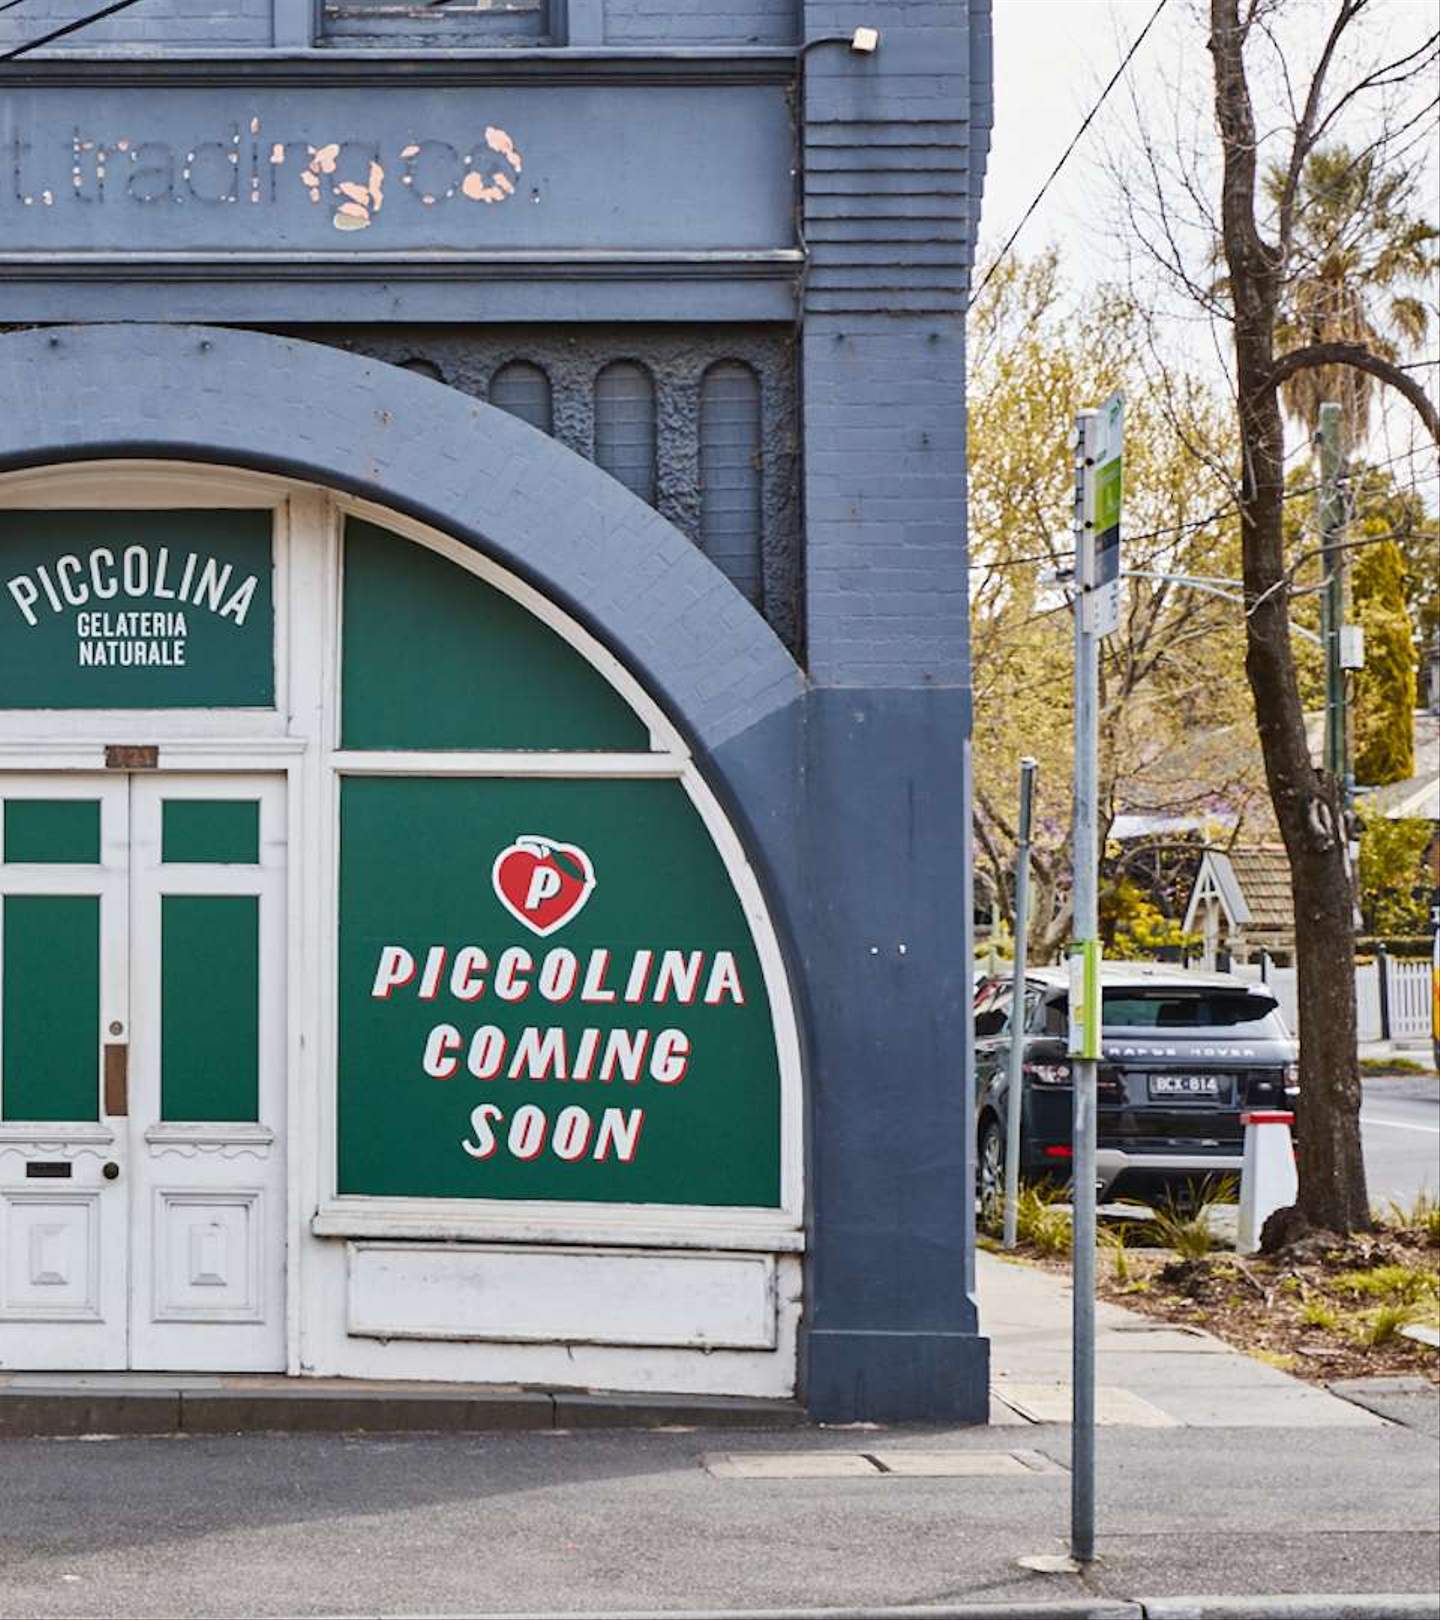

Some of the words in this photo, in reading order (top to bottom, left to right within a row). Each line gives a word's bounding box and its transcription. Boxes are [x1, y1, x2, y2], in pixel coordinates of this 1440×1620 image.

[7, 545, 258, 626] PICCOLINA
[77, 612, 187, 637] GELATERIA
[79, 640, 186, 666] NATURALE
[524, 865, 561, 910] P
[371, 945, 747, 1006] PICCOLINA
[422, 1024, 691, 1083] COMING
[461, 1103, 643, 1163] SOON
